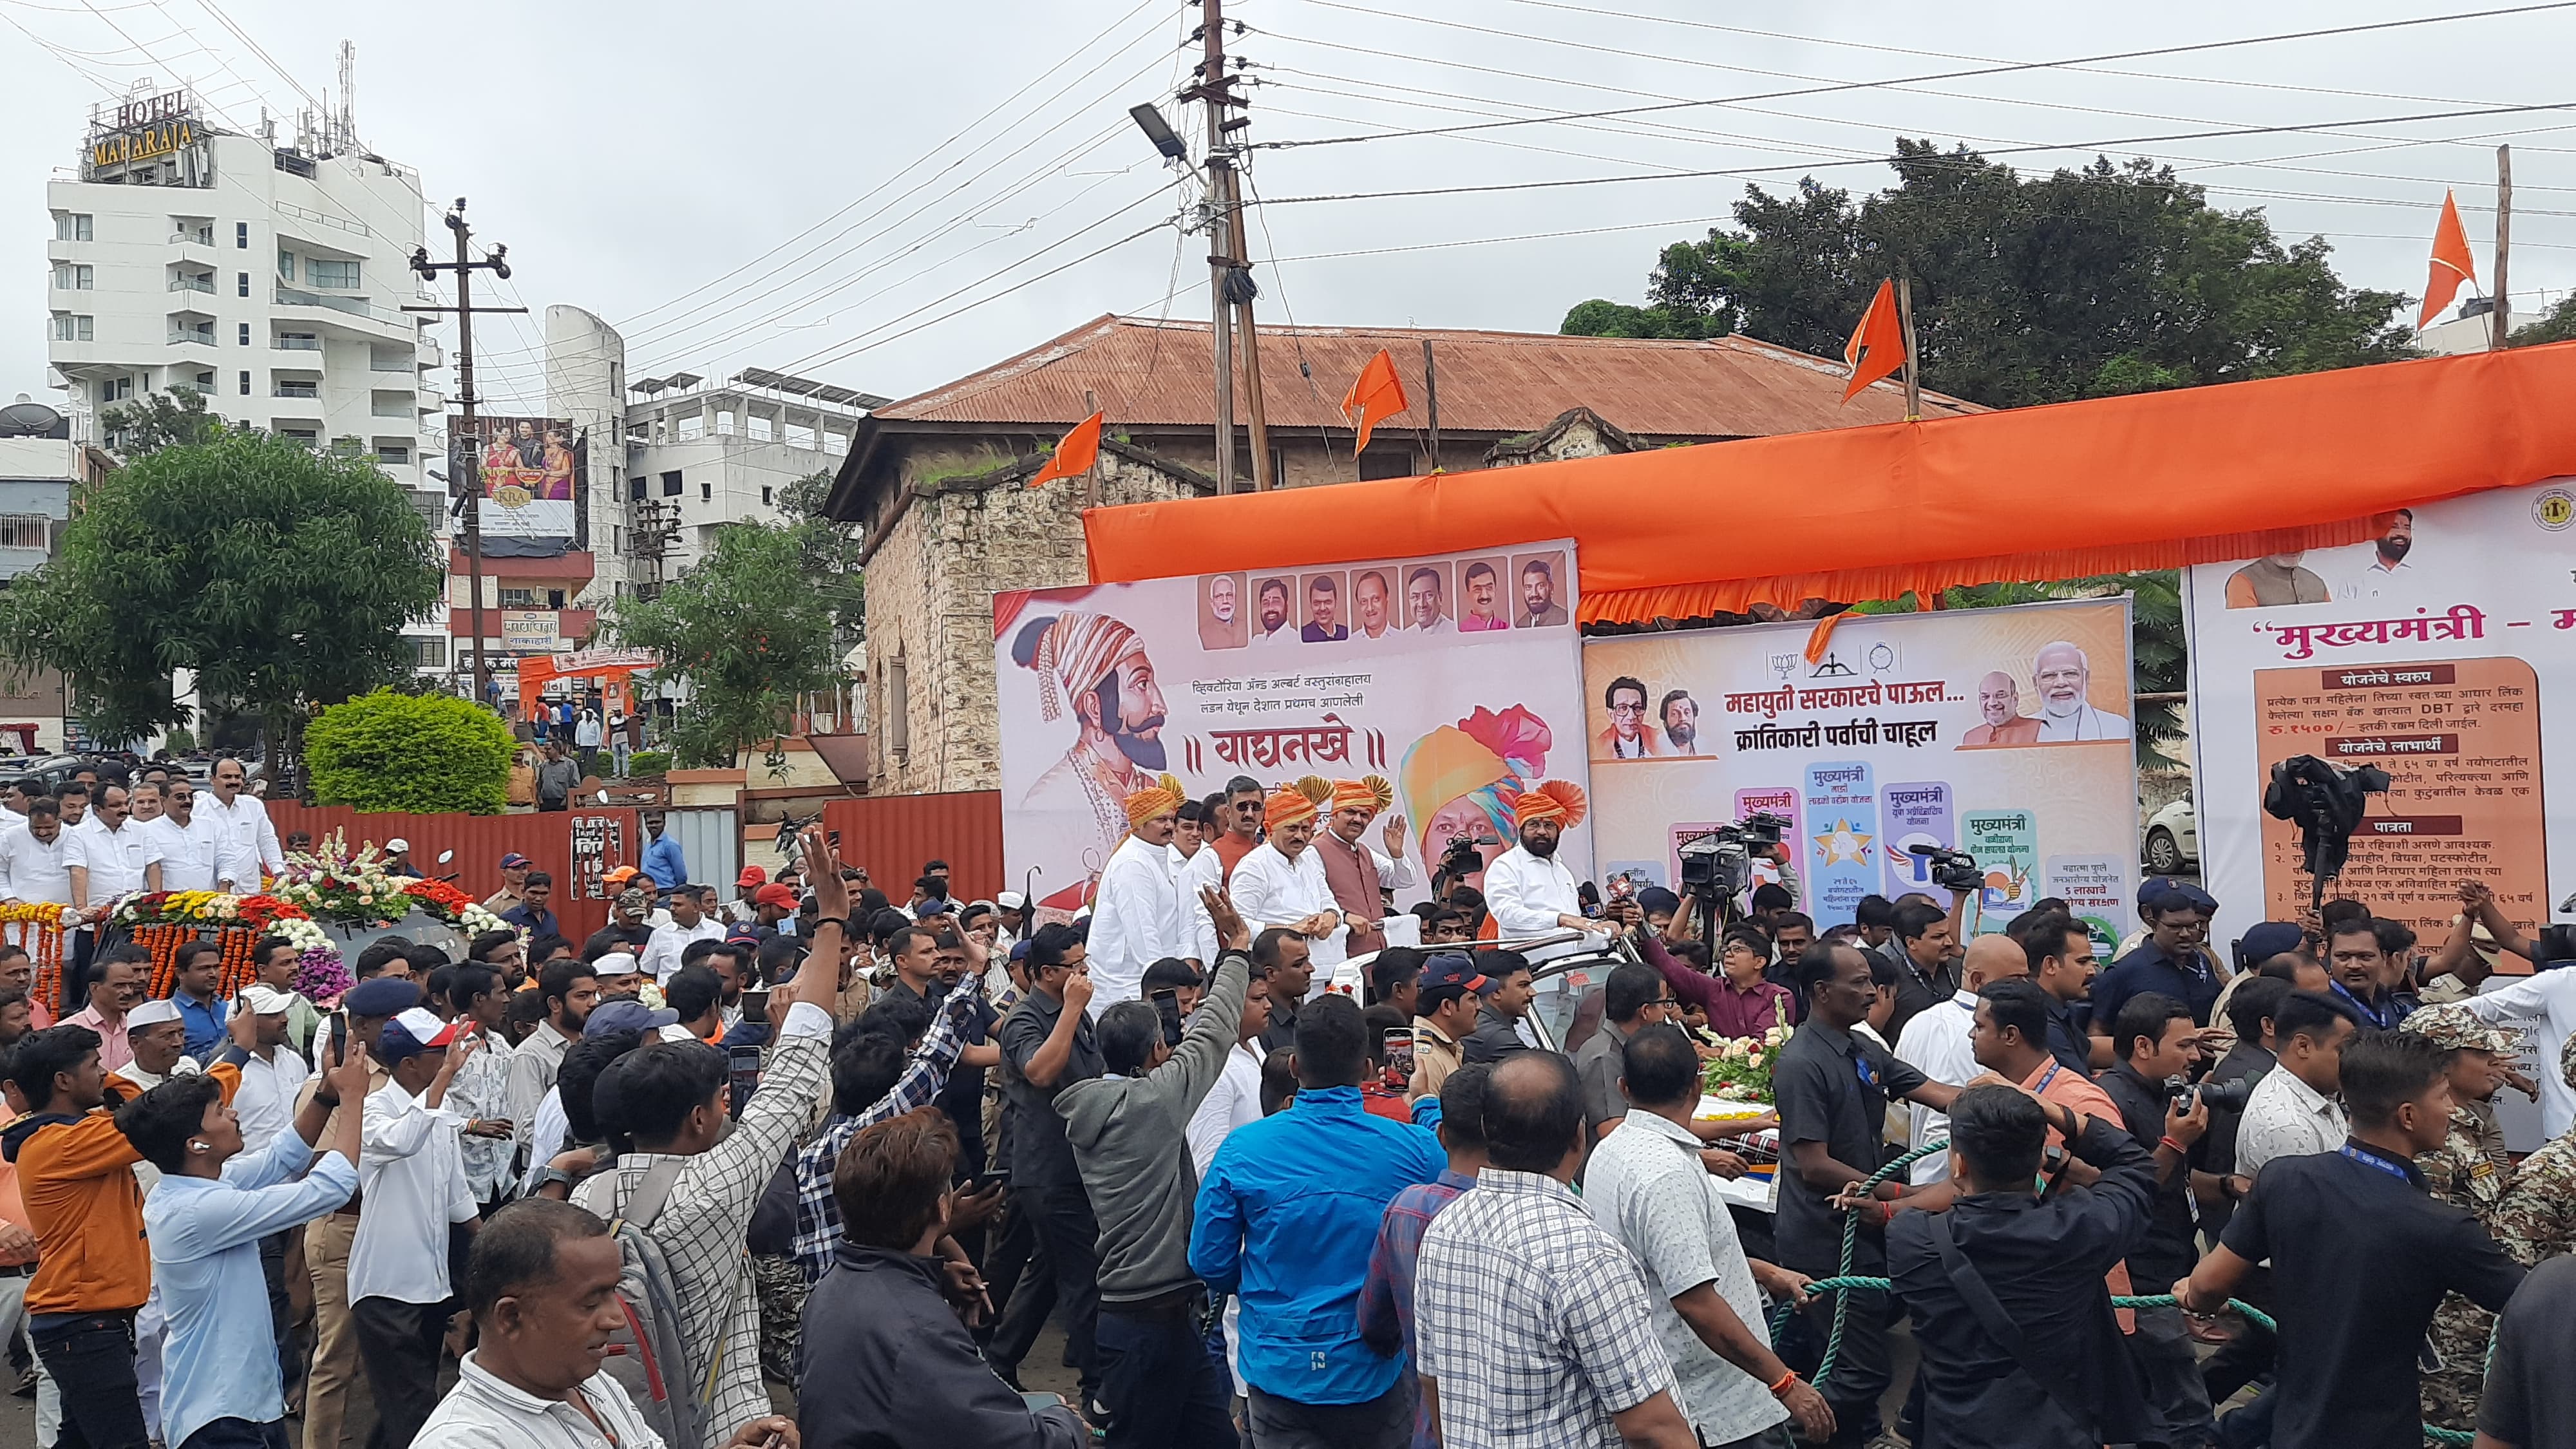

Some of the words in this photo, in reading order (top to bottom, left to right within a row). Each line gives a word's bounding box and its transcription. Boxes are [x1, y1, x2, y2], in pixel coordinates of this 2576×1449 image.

[117, 91, 189, 128] HOTEL
[94, 121, 192, 167] MAHARAJA
[1271, 674, 1301, 690] अल्बर्ट
[2340, 670, 2389, 686] योजनेचे
[1200, 700, 1224, 713] लंडन
[1227, 699, 1250, 715] येथून
[1253, 697, 1281, 713] देशात
[1320, 692, 1364, 708] आणलेली
[1724, 684, 1795, 719] महायुती
[1798, 679, 1882, 710] सरकारचे
[2266, 695, 2297, 707] प्रत्येक
[2302, 696, 2321, 705] पात्र
[2325, 692, 2367, 705] महिलेला
[2372, 691, 2402, 703] तिच्या
[2458, 688, 2492, 699] आधार
[2497, 685, 2524, 697] लिंक
[2372, 706, 2412, 717] खात्यात
[2421, 703, 2454, 714] DBT
[2462, 701, 2481, 715] द्वारे
[2489, 701, 2524, 713] दरमहा
[2358, 720, 2387, 733] इतकी
[2418, 718, 2443, 730] दिली
[2445, 717, 2481, 730] जाईल.
[1734, 721, 1821, 752] क्रांतिकारी
[1824, 717, 1879, 747] पर्वाची
[1882, 720, 1938, 747] चाहूल
[2338, 738, 2387, 753] योजनेचे
[2391, 735, 2442, 752] लाभार्थी
[2387, 758, 2396, 769] ते
[2403, 760, 2419, 770] ६५
[2425, 759, 2437, 768] या
[1812, 765, 1865, 787] मुख्यमंत्री
[2501, 770, 2530, 781] आणि
[1889, 786, 1944, 809] मुख्यमंत्री
[2390, 789, 2407, 798] त्या
[2414, 786, 2467, 800] कुटुंबातील
[2474, 784, 2504, 796] केवळ
[2510, 786, 2530, 797] एक
[1969, 814, 2027, 835] मुख्यमंत्री
[2372, 822, 2412, 833] पात्रता
[2367, 838, 2409, 851] रहिवाशी
[2412, 839, 2441, 850] असणे
[2443, 840, 2496, 850] आवश्यक.
[2347, 864, 2373, 875] आणि
[2376, 864, 2416, 876] निराधार
[2418, 865, 2451, 877] महिला
[2454, 865, 2481, 876] तसेच
[2484, 867, 2503, 876] त्या
[2065, 887, 2071, 895] 5
[2073, 884, 2107, 895] लाखाचे
[2344, 877, 2373, 888] केवळ
[2374, 880, 2392, 889] एक
[2395, 877, 2447, 890] अविवाहित
[2363, 893, 2377, 902] २१
[2397, 891, 2415, 905] पूर्ण
[2416, 893, 2425, 902] व
[2499, 893, 2514, 903] ६५
[2419, 917, 2444, 928] लिंक
